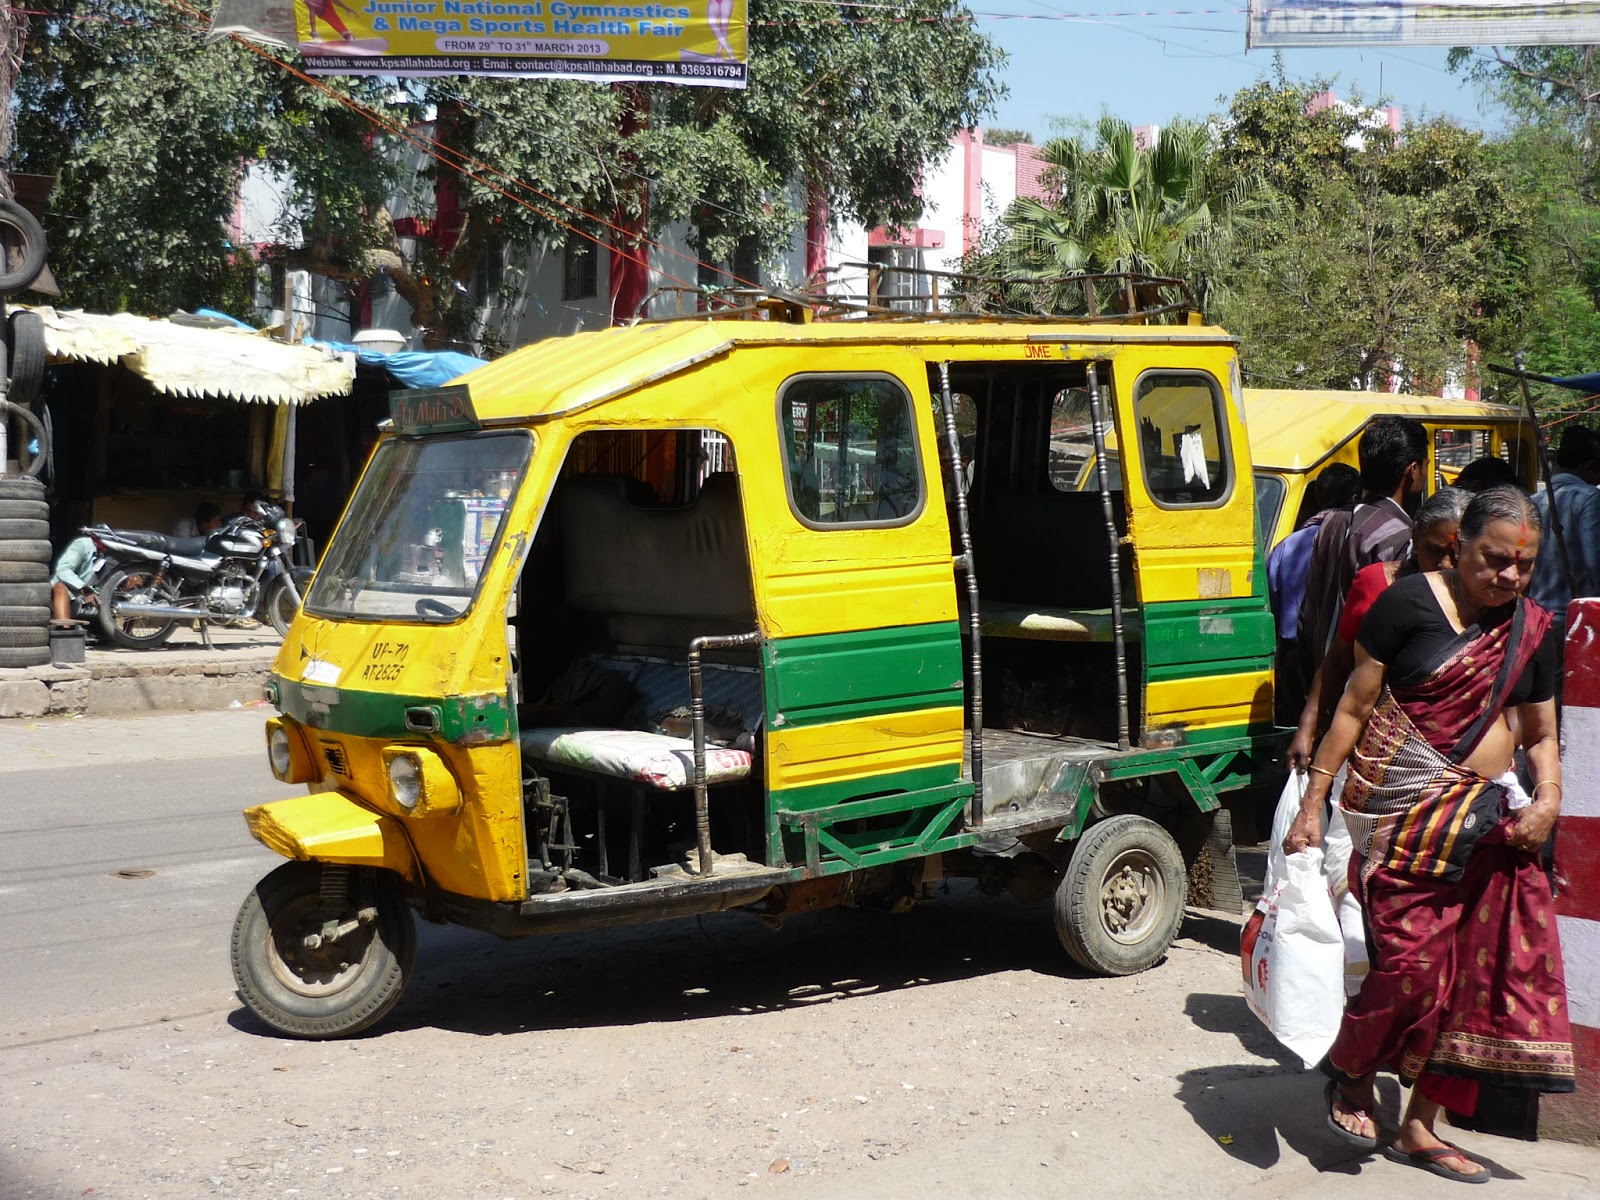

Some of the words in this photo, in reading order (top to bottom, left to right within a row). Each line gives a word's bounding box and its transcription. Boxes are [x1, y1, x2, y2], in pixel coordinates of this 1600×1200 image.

[364, 0, 436, 14] Junior
[444, 0, 542, 15] National
[550, 2, 690, 19] Gymnastics
[373, 16, 390, 31] &
[399, 17, 462, 34] Mega
[469, 18, 546, 35] Sports
[553, 19, 631, 35] Health
[638, 21, 685, 36] Fair
[445, 41, 476, 51] FROM
[498, 42, 513, 52] TO
[535, 43, 574, 53] MARCH
[578, 44, 601, 53] 2013
[305, 57, 351, 68] Website:
[353, 58, 471, 71] www.kpsallahabad.org
[515, 60, 654, 75] contact@kpsallahabad.org
[666, 63, 679, 75] M.
[681, 64, 742, 77] 9369316794
